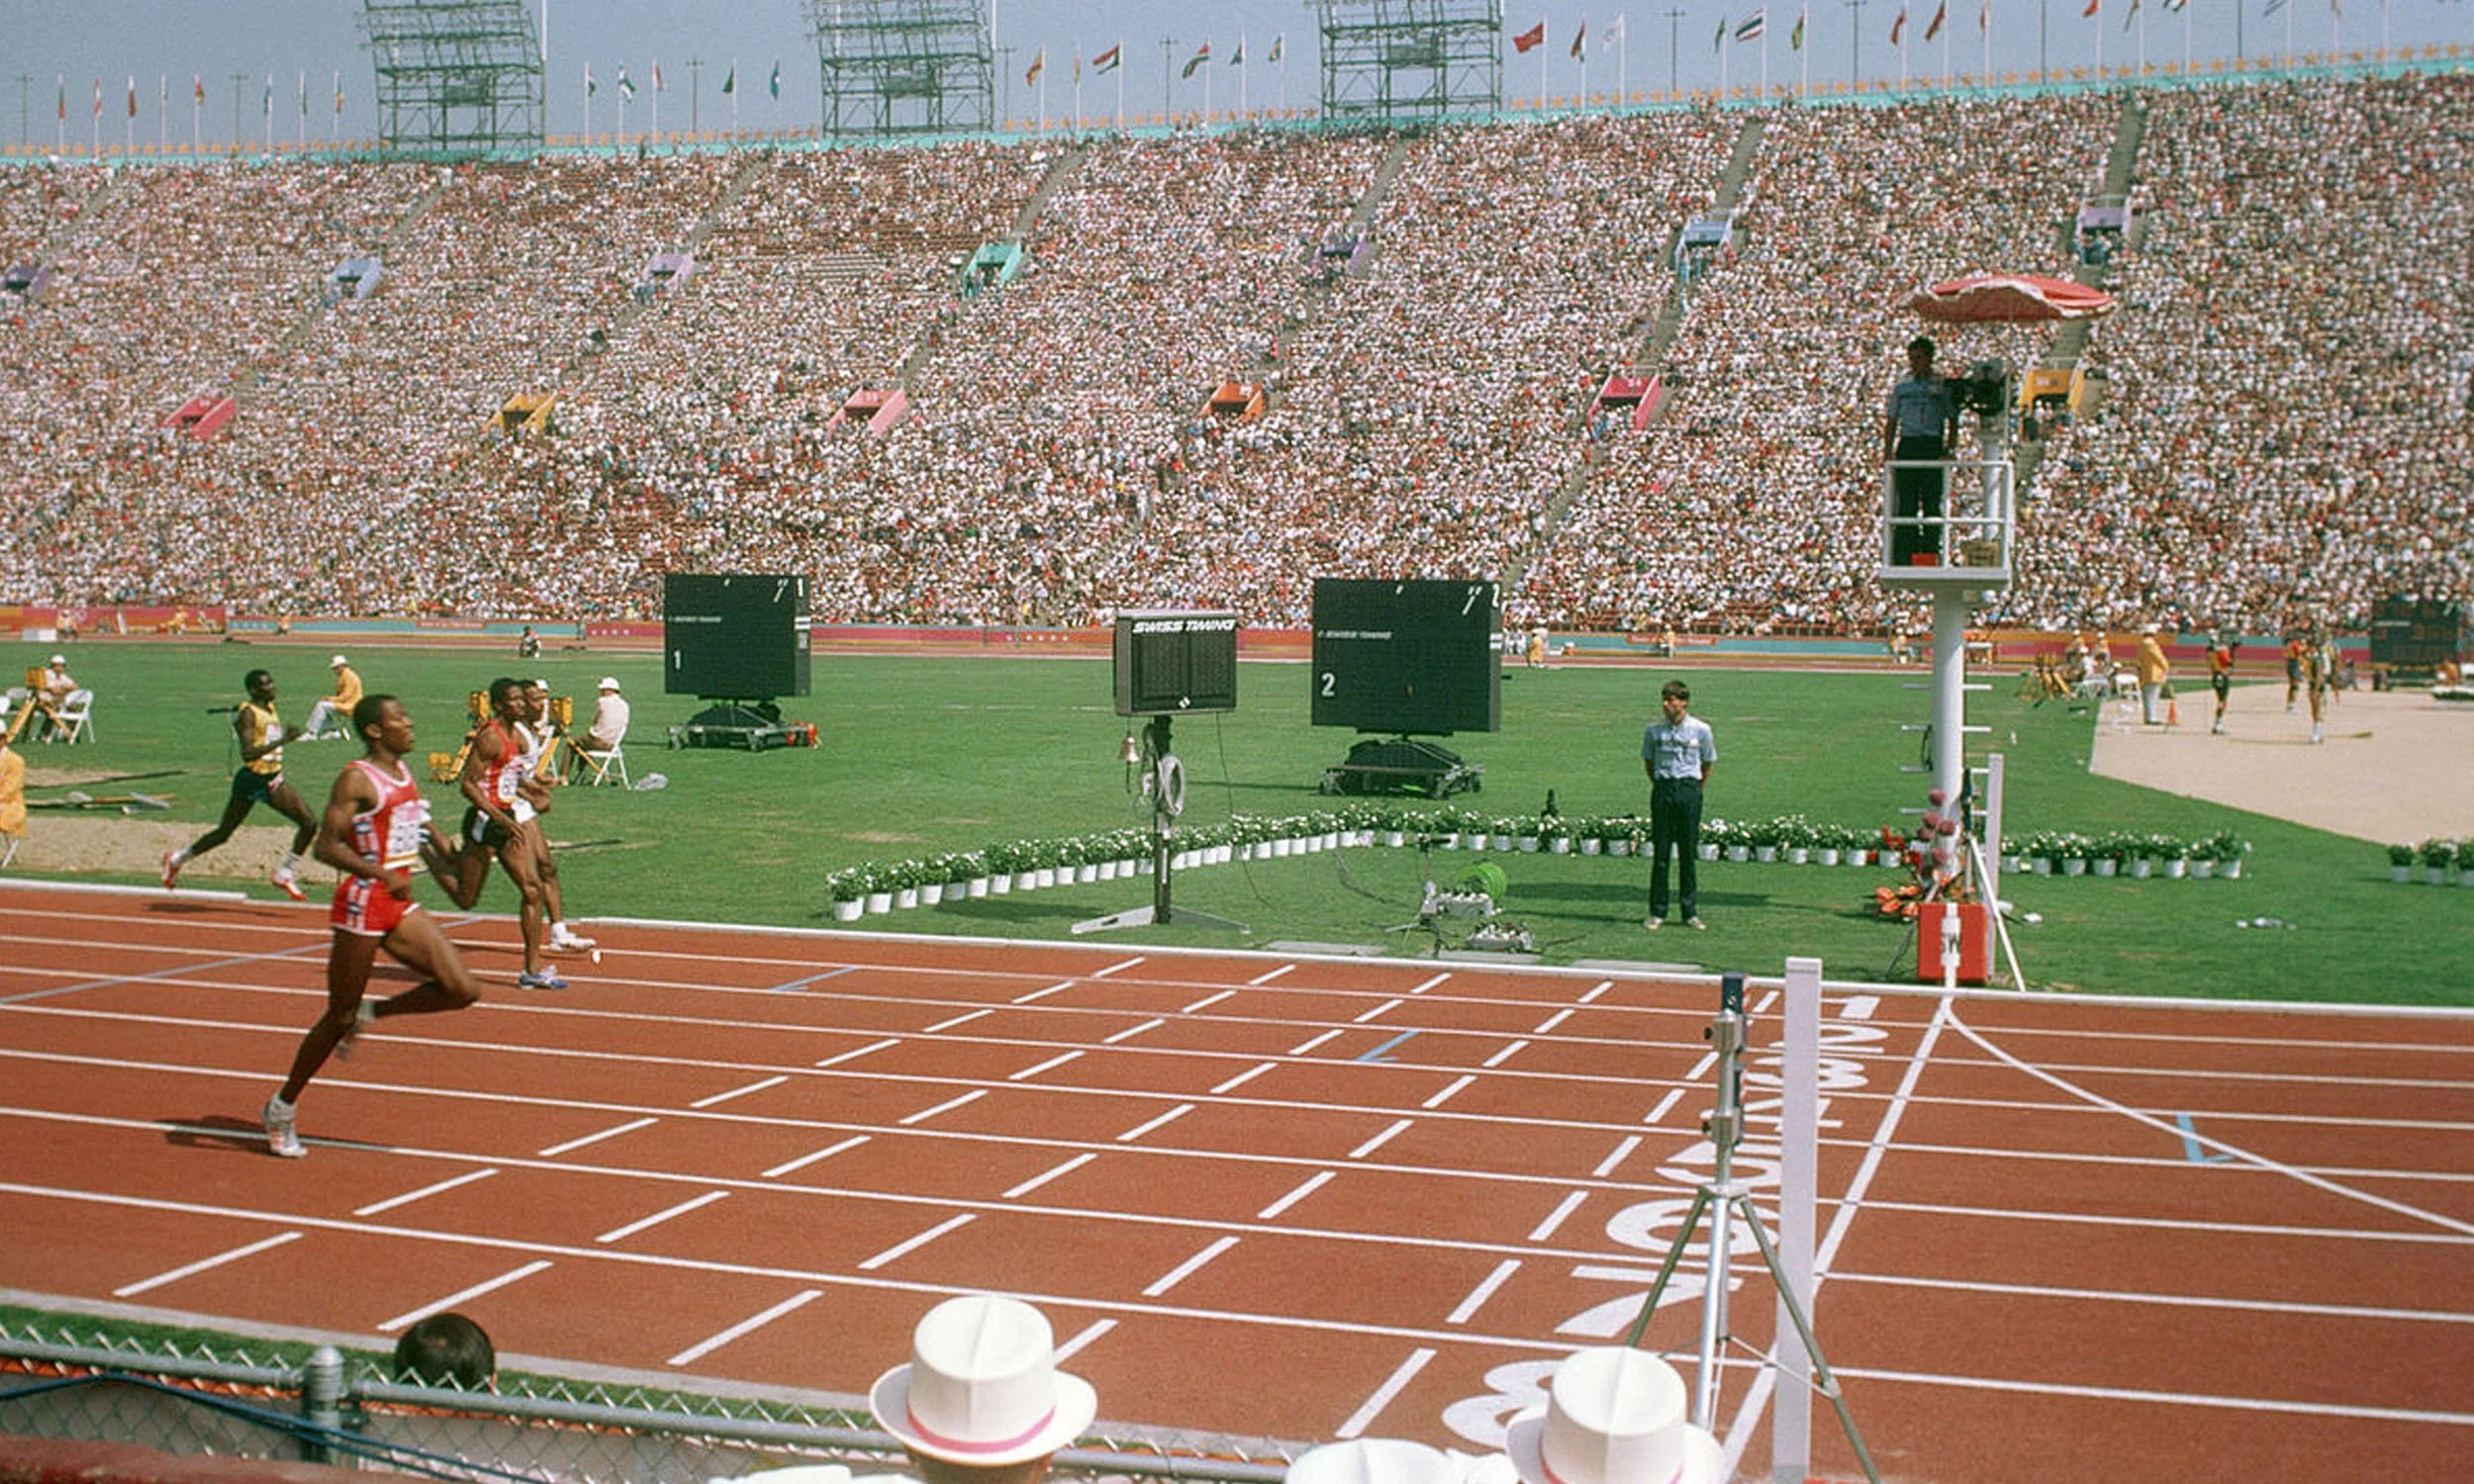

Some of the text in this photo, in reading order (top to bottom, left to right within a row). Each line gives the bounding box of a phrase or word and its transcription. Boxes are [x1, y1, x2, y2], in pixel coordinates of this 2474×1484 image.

[1132, 619, 1236, 633] SWISS TIMING
[673, 649, 681, 671] 1
[1320, 672, 1336, 697] 2
[1745, 1056, 1869, 1089] 3
[1654, 1140, 1782, 1188] 5
[1605, 1198, 1781, 1256] 6
[1553, 1264, 1744, 1339] 7
